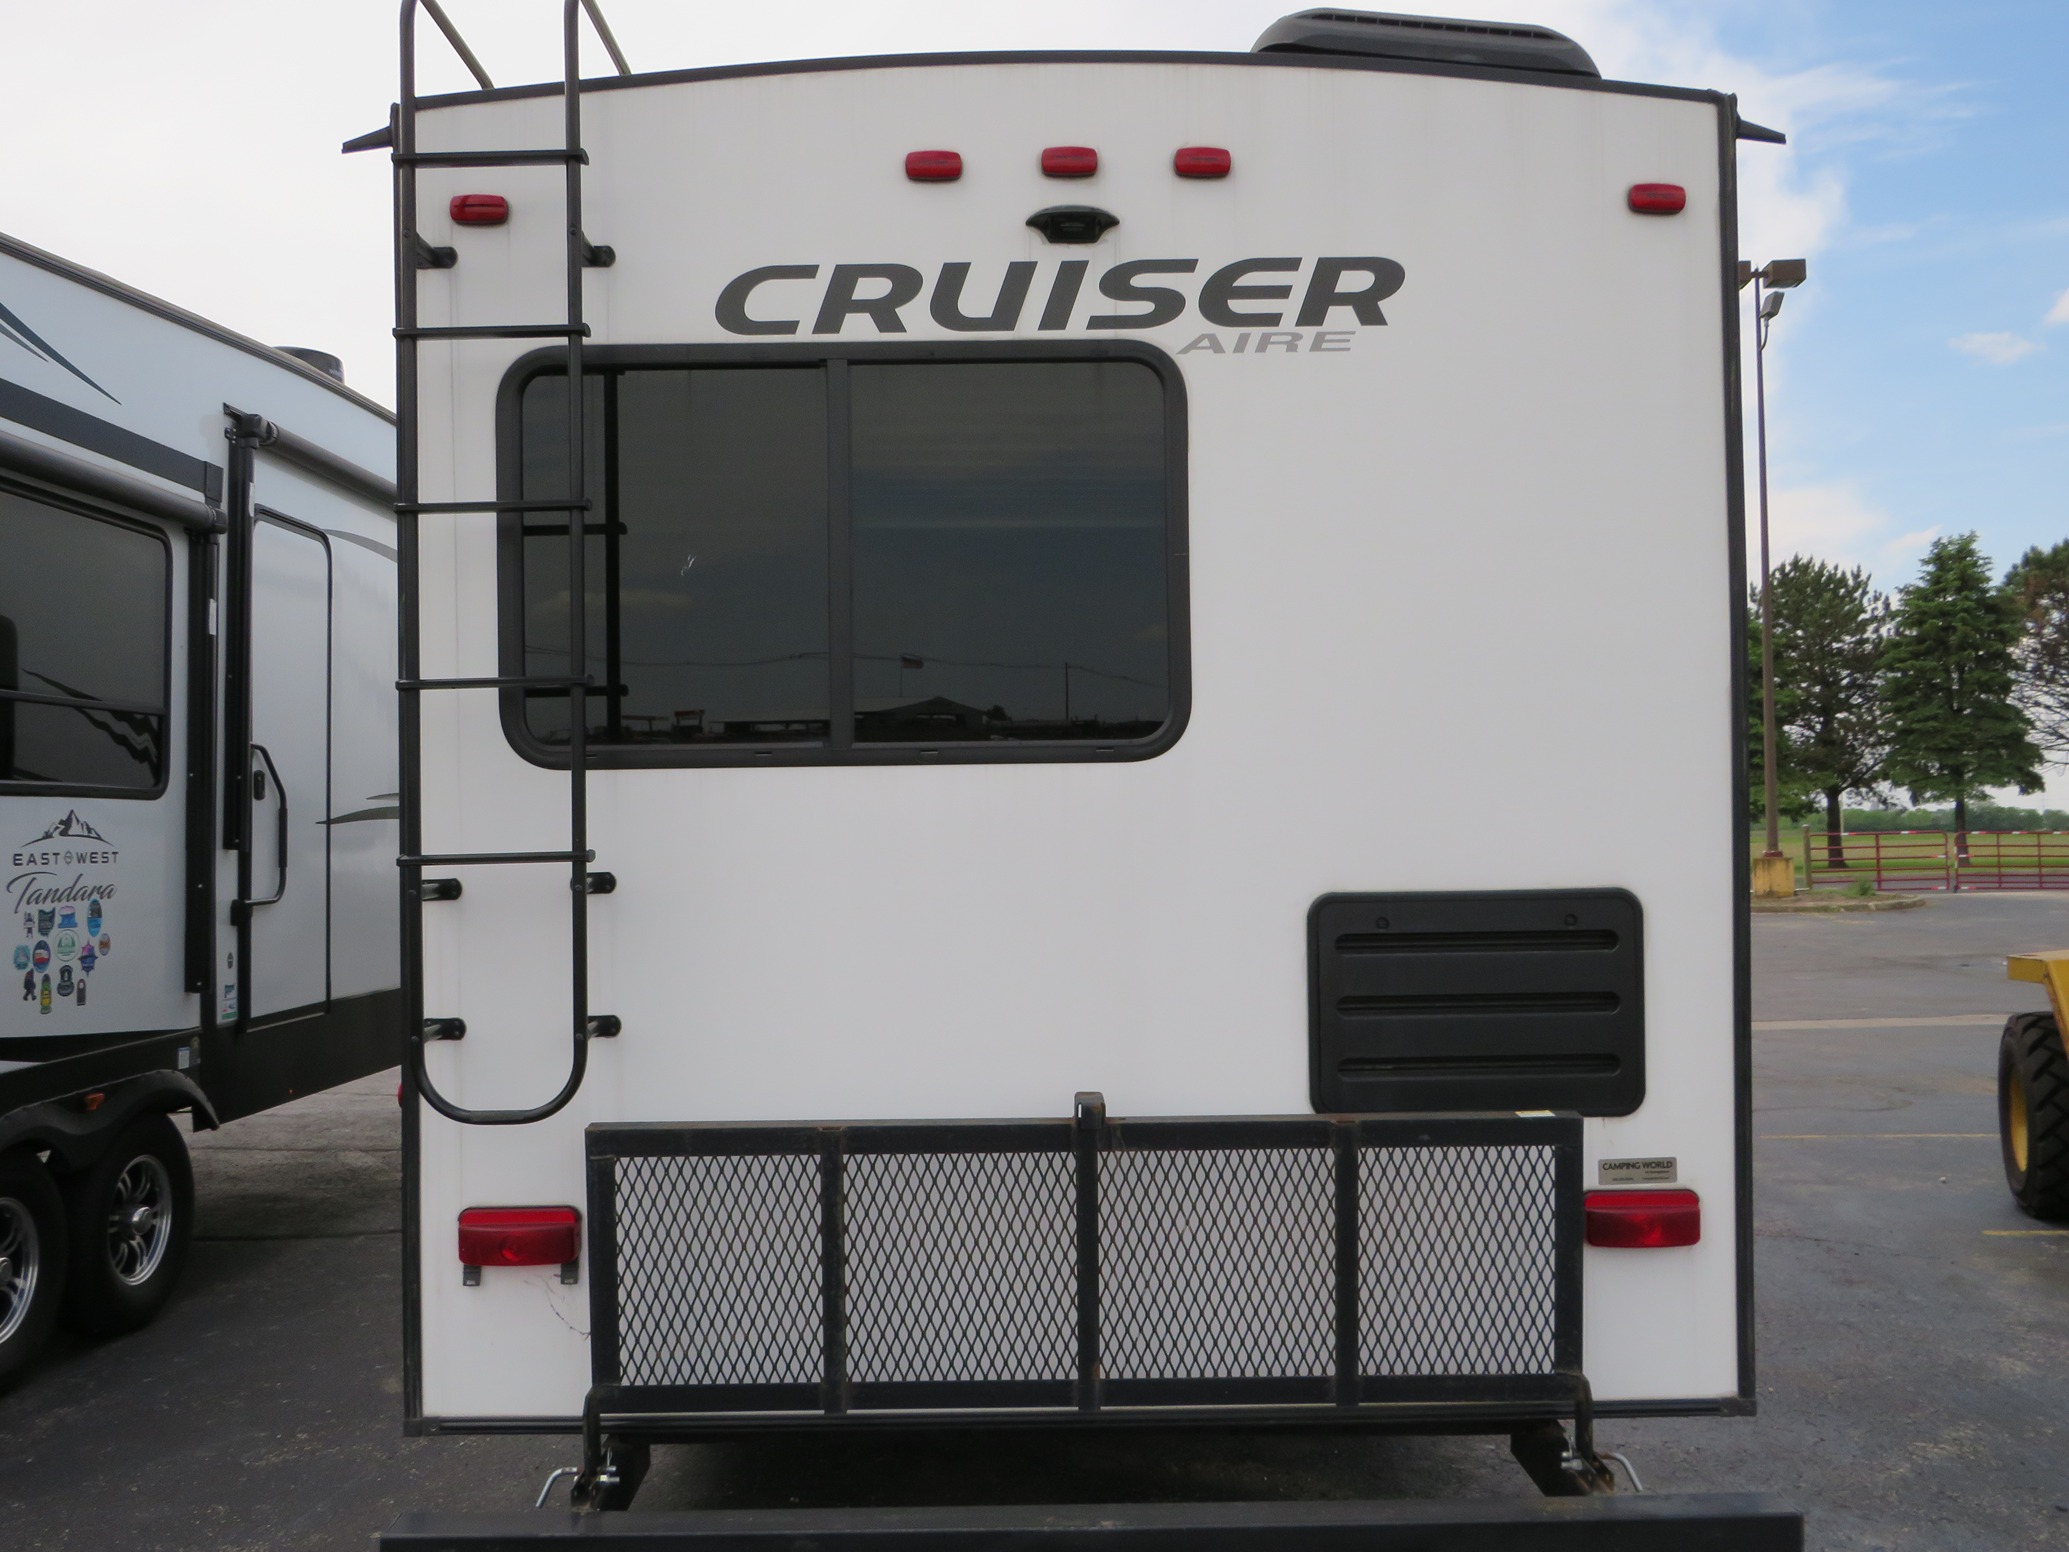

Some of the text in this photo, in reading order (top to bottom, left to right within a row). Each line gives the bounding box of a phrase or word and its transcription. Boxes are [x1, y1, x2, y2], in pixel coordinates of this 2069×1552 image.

[714, 256, 1406, 336] CRUISER
[1174, 330, 1357, 355] AIRE
[12, 851, 119, 866] EAST WEST
[6, 872, 117, 914] Tandara
[1602, 1161, 1672, 1171] CAMPING WORLD
